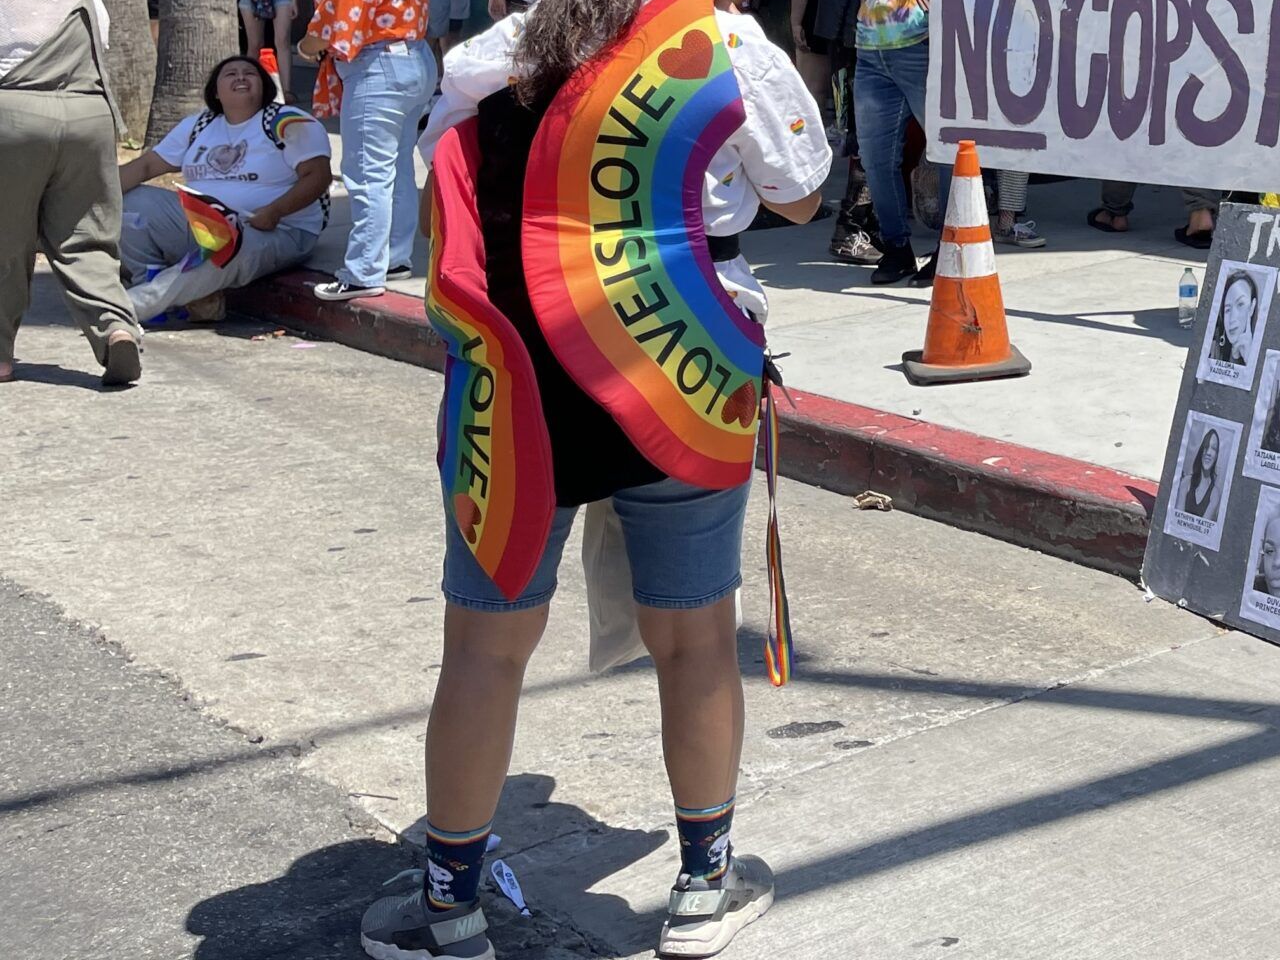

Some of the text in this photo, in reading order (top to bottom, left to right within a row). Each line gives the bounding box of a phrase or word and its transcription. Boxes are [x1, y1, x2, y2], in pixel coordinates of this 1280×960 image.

[590, 73, 733, 416] LOVE IS LOVE
